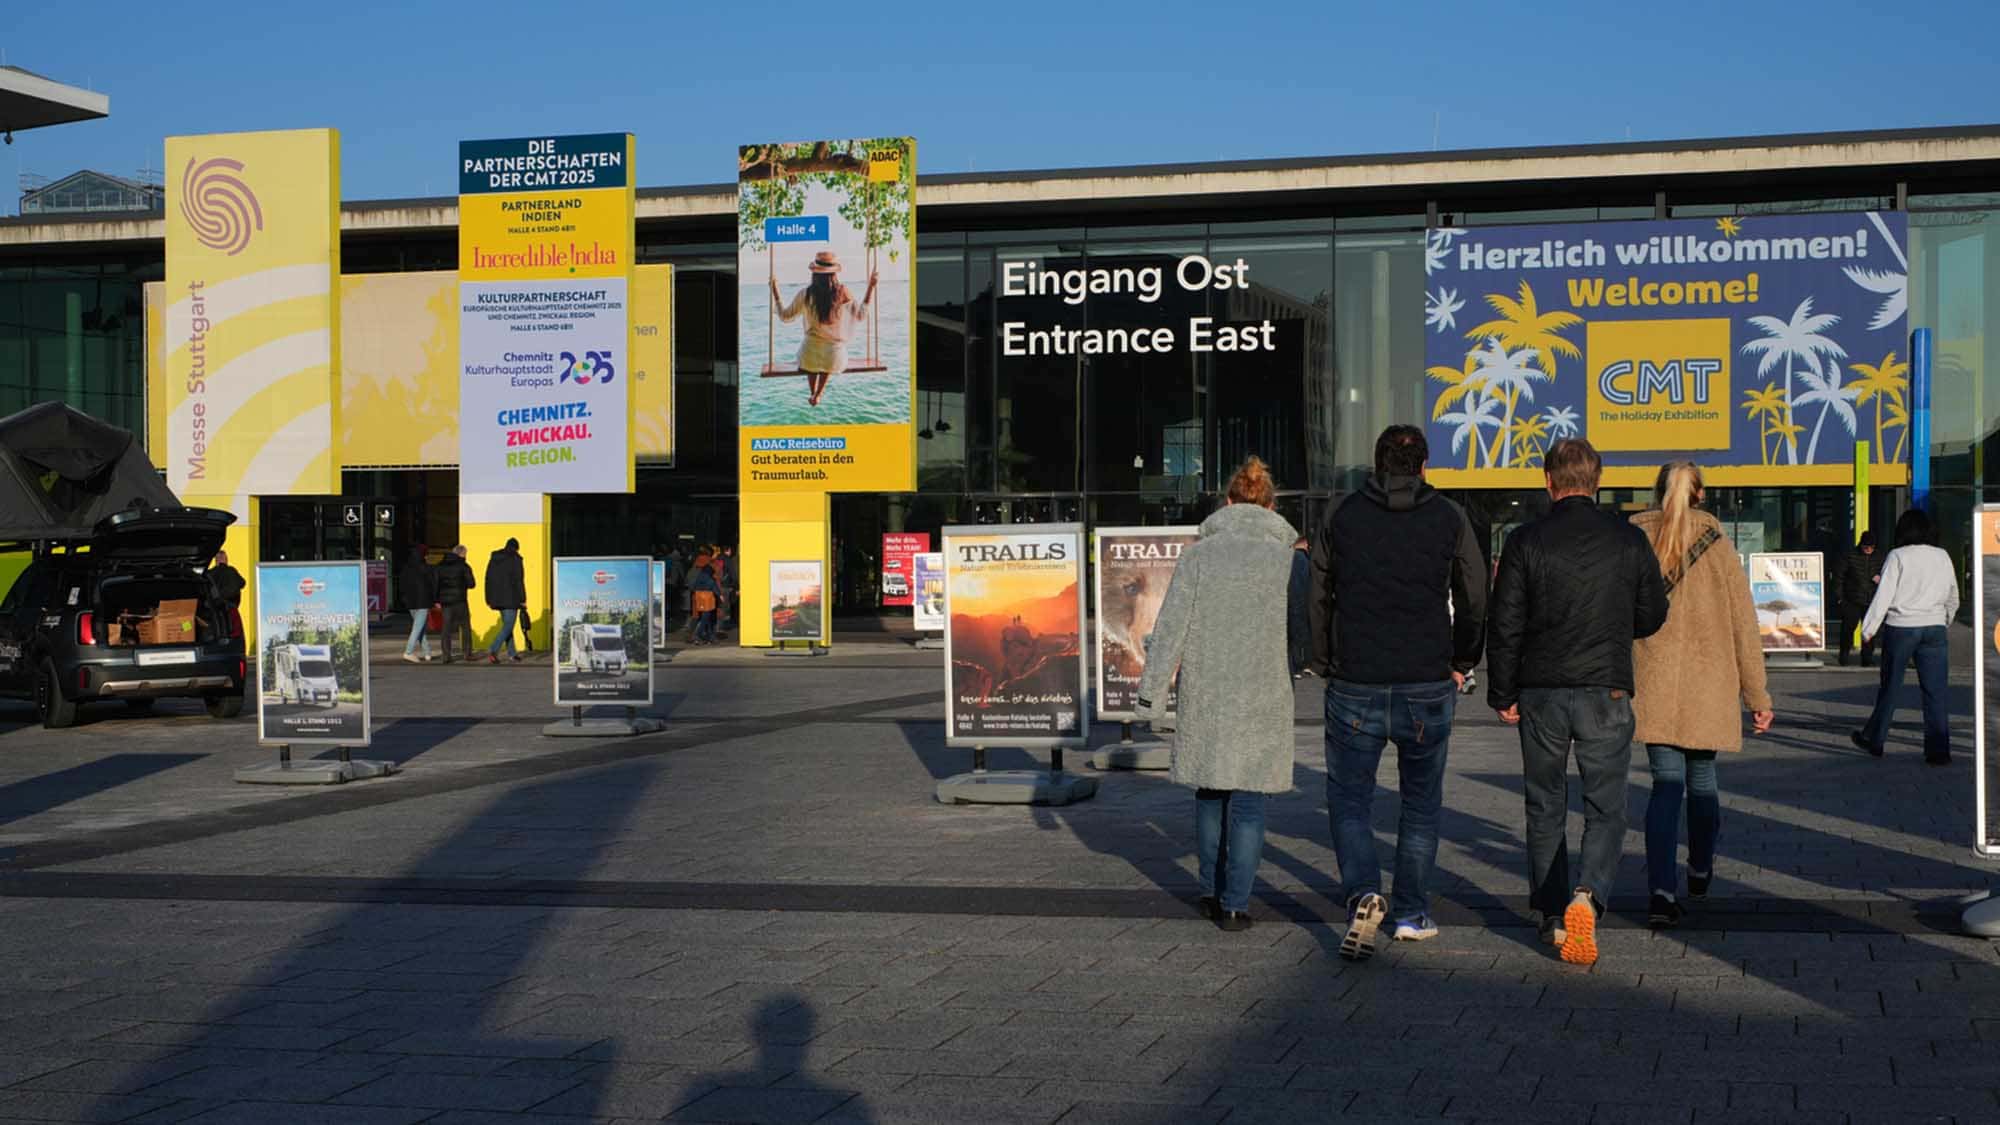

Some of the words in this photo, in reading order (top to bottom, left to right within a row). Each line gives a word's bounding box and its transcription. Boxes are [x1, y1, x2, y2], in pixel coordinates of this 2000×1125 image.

[528, 140, 556, 155] DIE
[464, 152, 621, 173] PARTNERSCHAFTEN
[870, 150, 899, 162] ADAC
[490, 173, 521, 188] DER
[523, 171, 557, 187] CMT
[560, 170, 596, 185] 2025
[501, 199, 583, 212] PARTNERLAND
[522, 211, 562, 222] INDIEN
[508, 226, 531, 234] HALLE
[537, 225, 560, 233] STAND
[777, 224, 806, 235] Halle
[808, 223, 816, 234] 4
[473, 242, 568, 269] Incredible
[1459, 238, 1606, 271] Herzlich
[1614, 229, 1868, 265] willkommen!
[1003, 261, 1163, 304] Eingang
[1177, 254, 1250, 291] Ost
[478, 290, 607, 304] KULTURPARTNERSCHAFT
[1567, 272, 1759, 308] Welcome!
[463, 303, 507, 312] EUROPÄISCHE
[508, 303, 573, 312] KULTURHAUPTSTADT
[573, 302, 607, 311] CHEMNITZ
[488, 313, 503, 321] UND
[187, 280, 210, 394] Stuttgart
[1003, 321, 1175, 355] Entrance
[1189, 317, 1277, 352] East
[503, 352, 554, 362] Chemnitz
[465, 364, 554, 377] Kulturhauptstadt
[560, 351, 615, 384] 2025
[511, 377, 554, 389] Europas
[1598, 359, 1722, 406] CMT
[497, 402, 592, 426] CHEMNITZ.
[1600, 411, 1619, 421] The
[1620, 410, 1662, 422] Holiday
[1664, 409, 1719, 421] Exhibition
[188, 402, 206, 480] Messe
[506, 424, 592, 447] ZWICKAU.
[753, 439, 786, 449] ADAC
[788, 438, 844, 449] Reisebüro
[506, 446, 576, 469] REGION.
[751, 455, 771, 464] Gut
[773, 454, 817, 464] beraten
[819, 453, 830, 464] in
[832, 453, 854, 464] den
[751, 468, 829, 480] Traumurlaub.
[959, 542, 1066, 562] TRAILS
